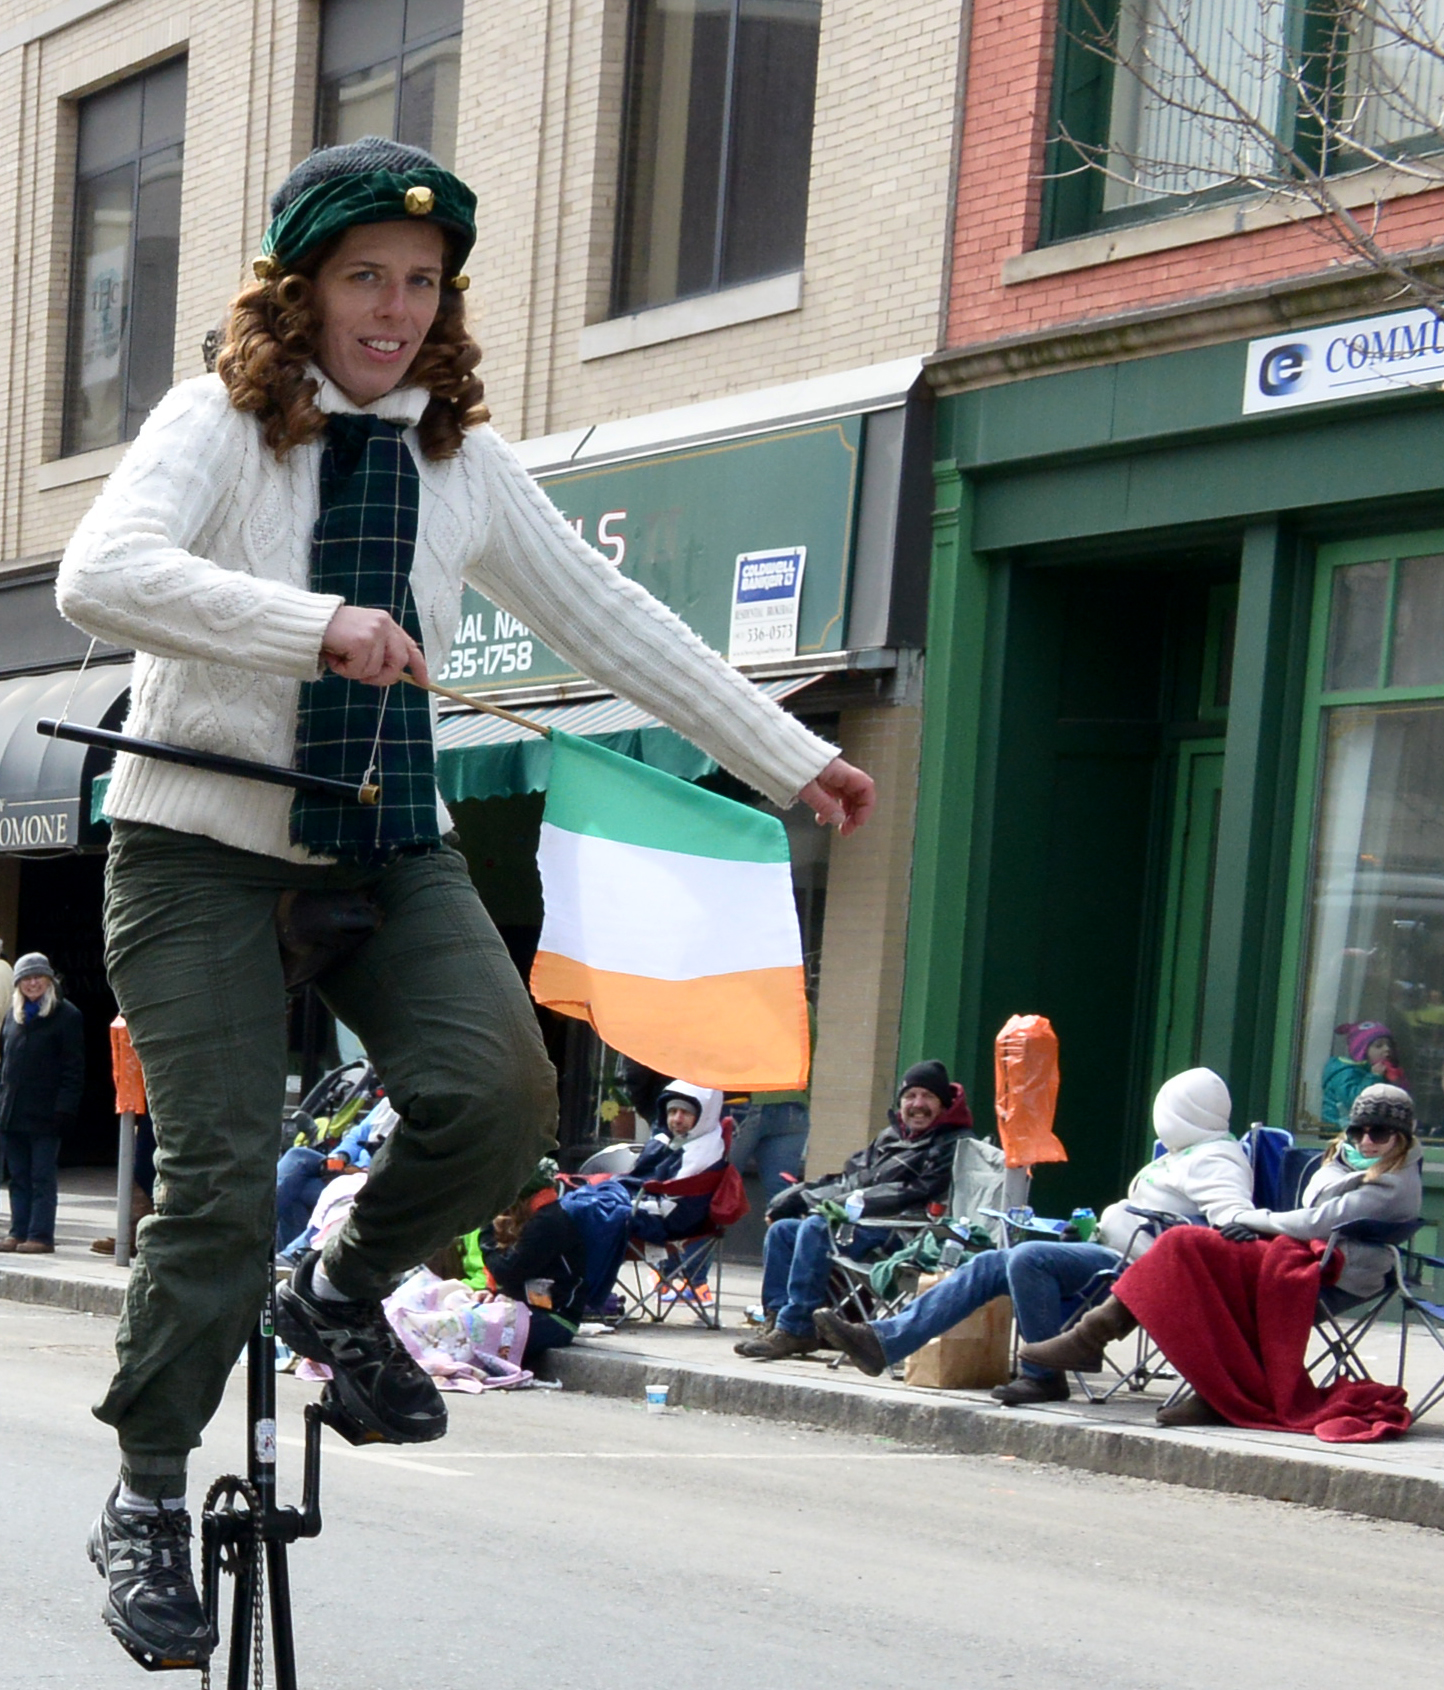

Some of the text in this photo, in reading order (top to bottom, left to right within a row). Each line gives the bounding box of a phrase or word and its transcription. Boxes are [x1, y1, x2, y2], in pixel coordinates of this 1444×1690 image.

[741, 559, 796, 578] COLDWELL
[740, 573, 784, 591] BANKER
[747, 624, 794, 642] 536-0573
